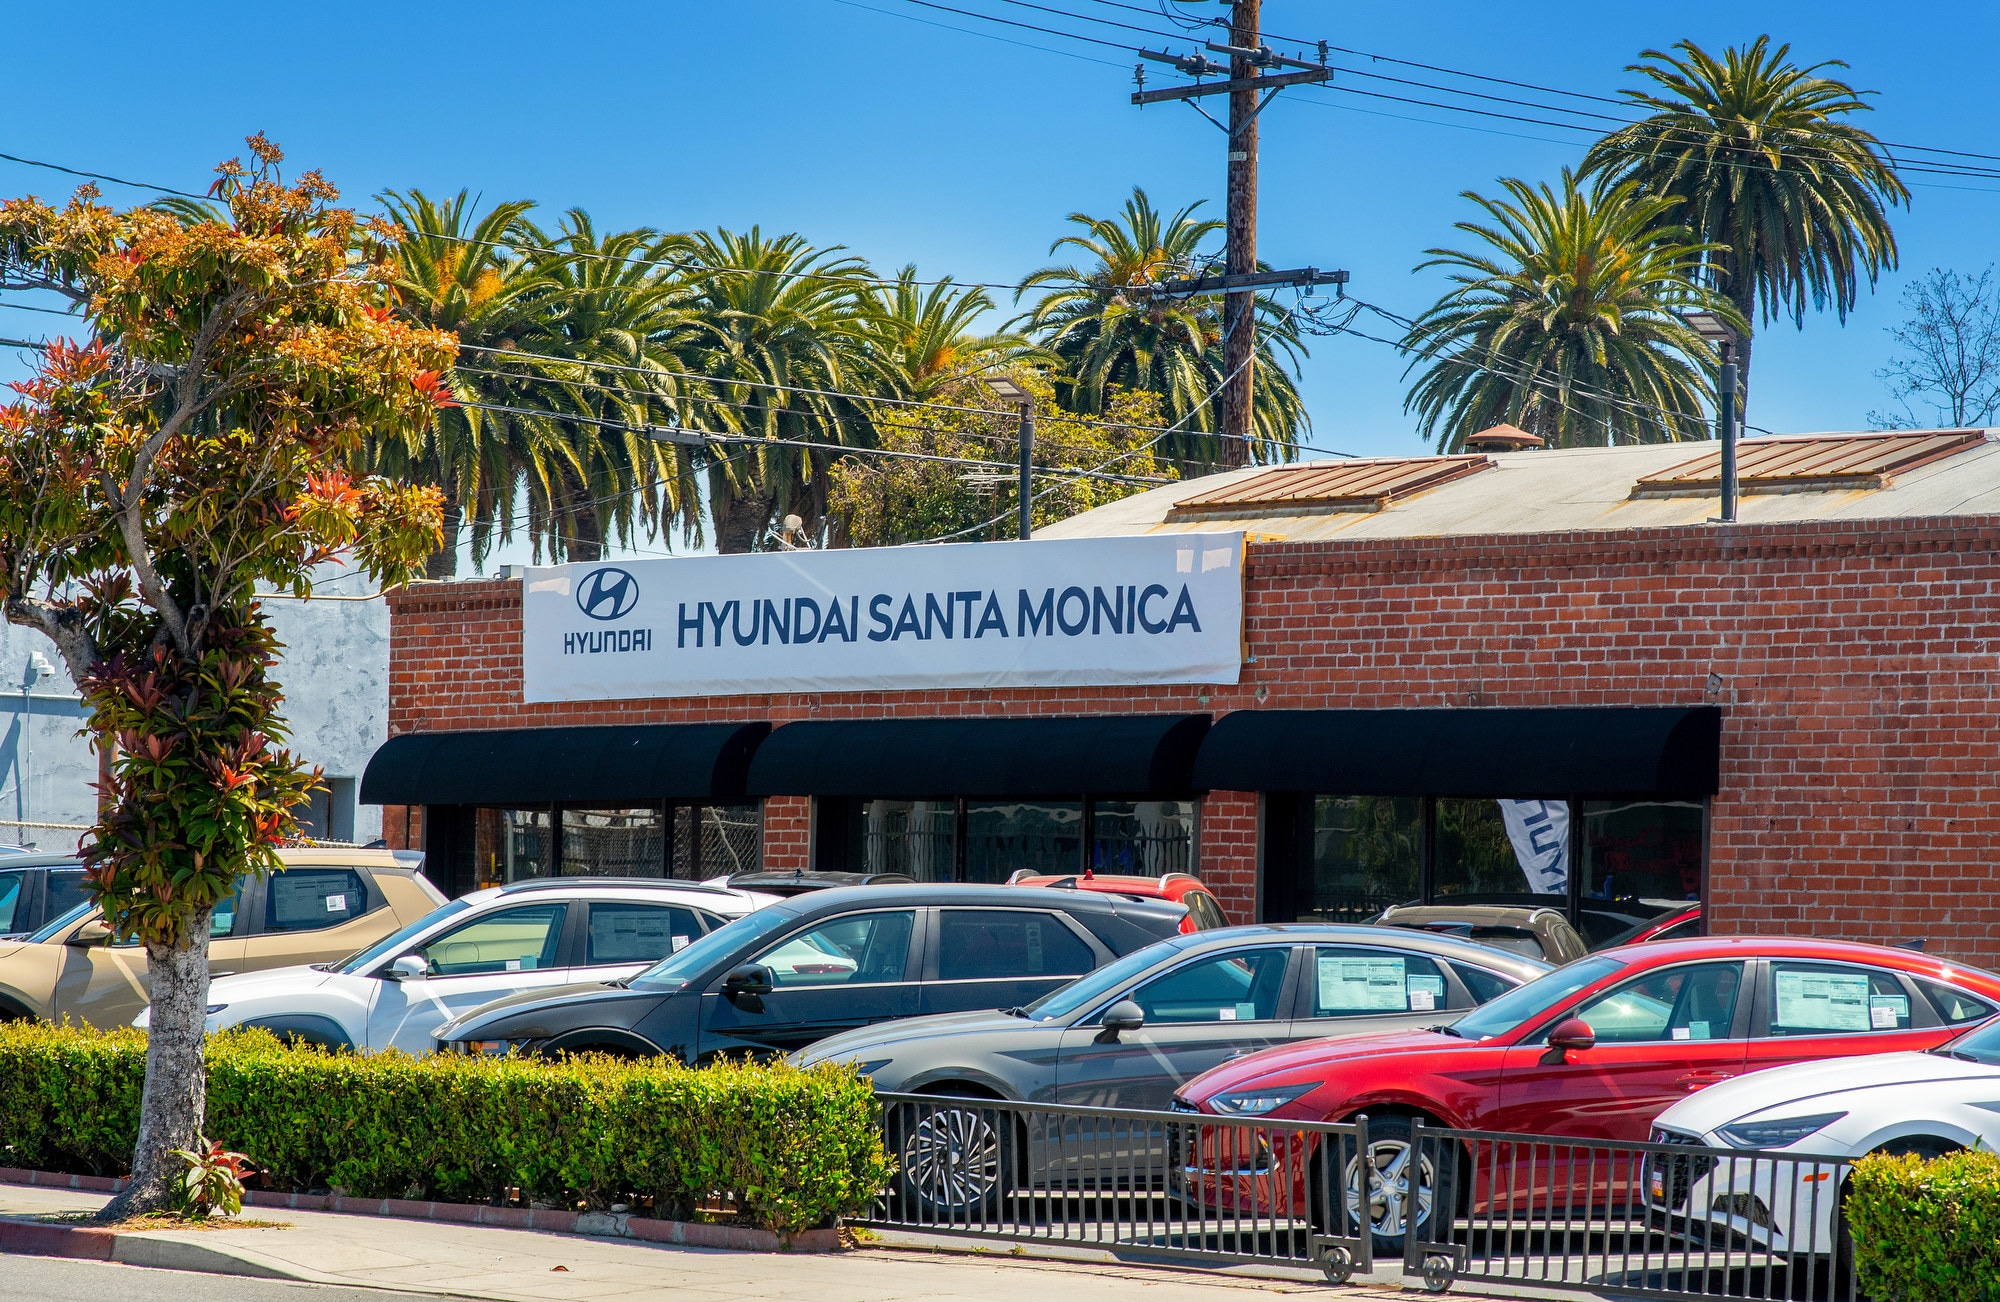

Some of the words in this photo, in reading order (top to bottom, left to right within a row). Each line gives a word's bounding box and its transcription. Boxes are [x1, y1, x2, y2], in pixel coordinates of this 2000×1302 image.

[678, 594, 859, 649] HYUNDAI
[867, 588, 1010, 643] SANTA
[1017, 582, 1203, 638] MONICA
[564, 628, 652, 655] HYUNDAI
